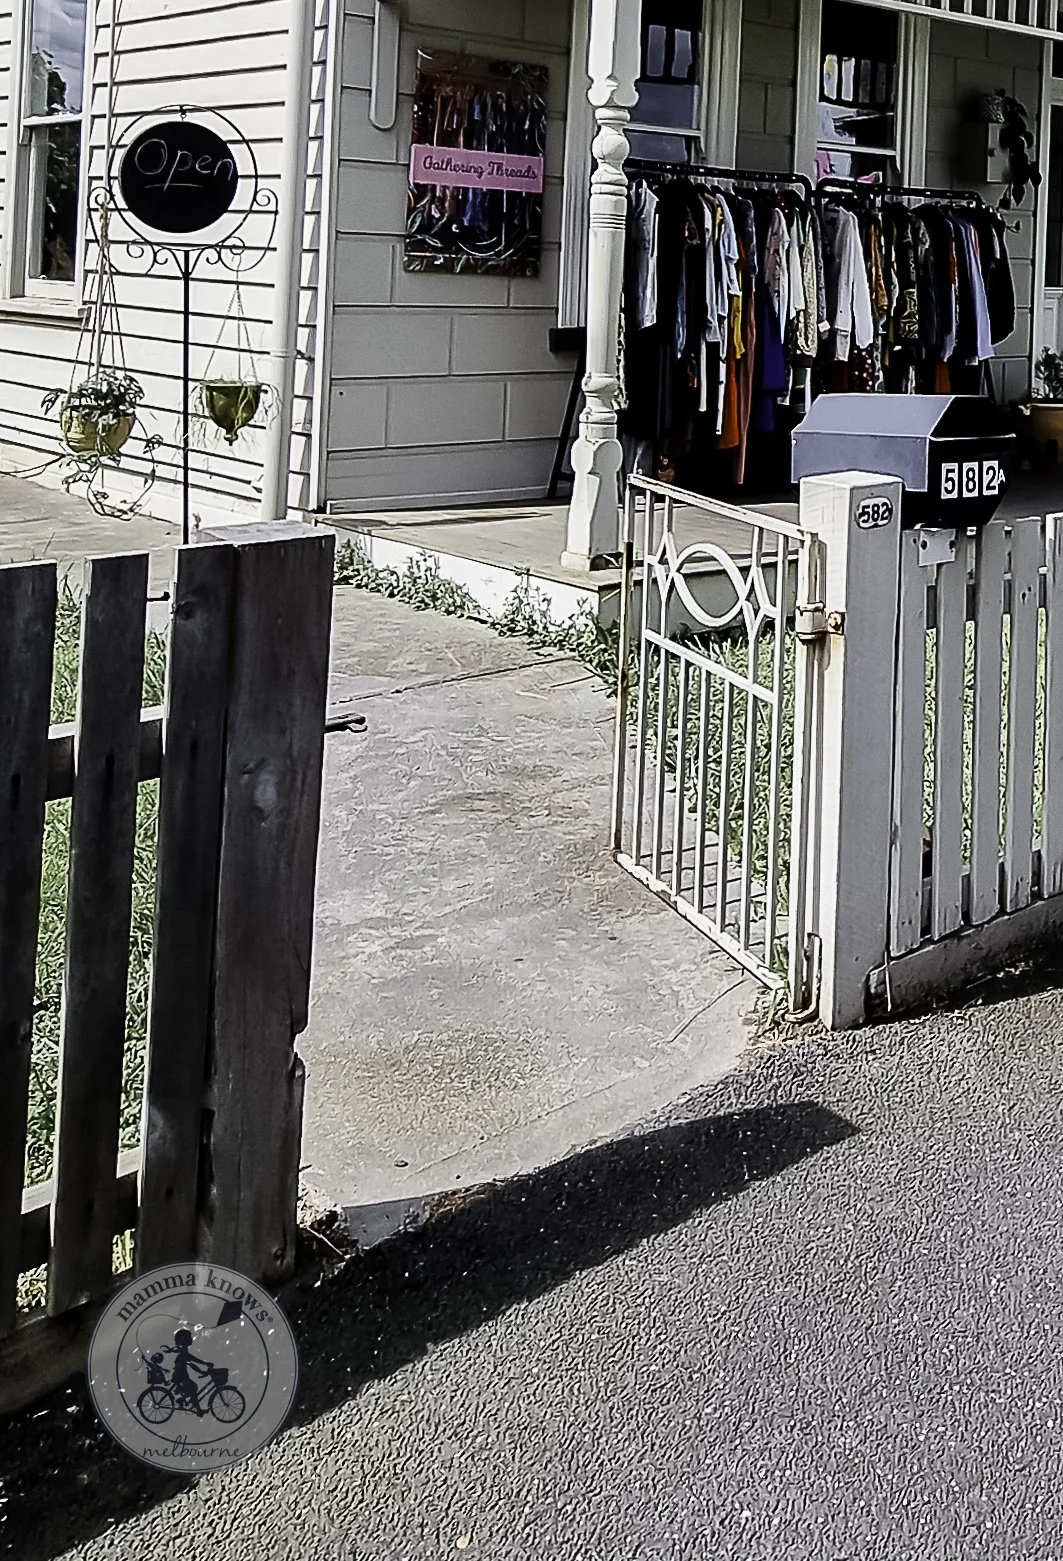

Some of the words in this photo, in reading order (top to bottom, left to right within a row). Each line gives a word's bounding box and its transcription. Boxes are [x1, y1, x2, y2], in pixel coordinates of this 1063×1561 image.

[135, 139, 234, 191] Open
[422, 154, 485, 179] Gathering
[487, 160, 538, 179] Threads
[859, 501, 891, 523] 582
